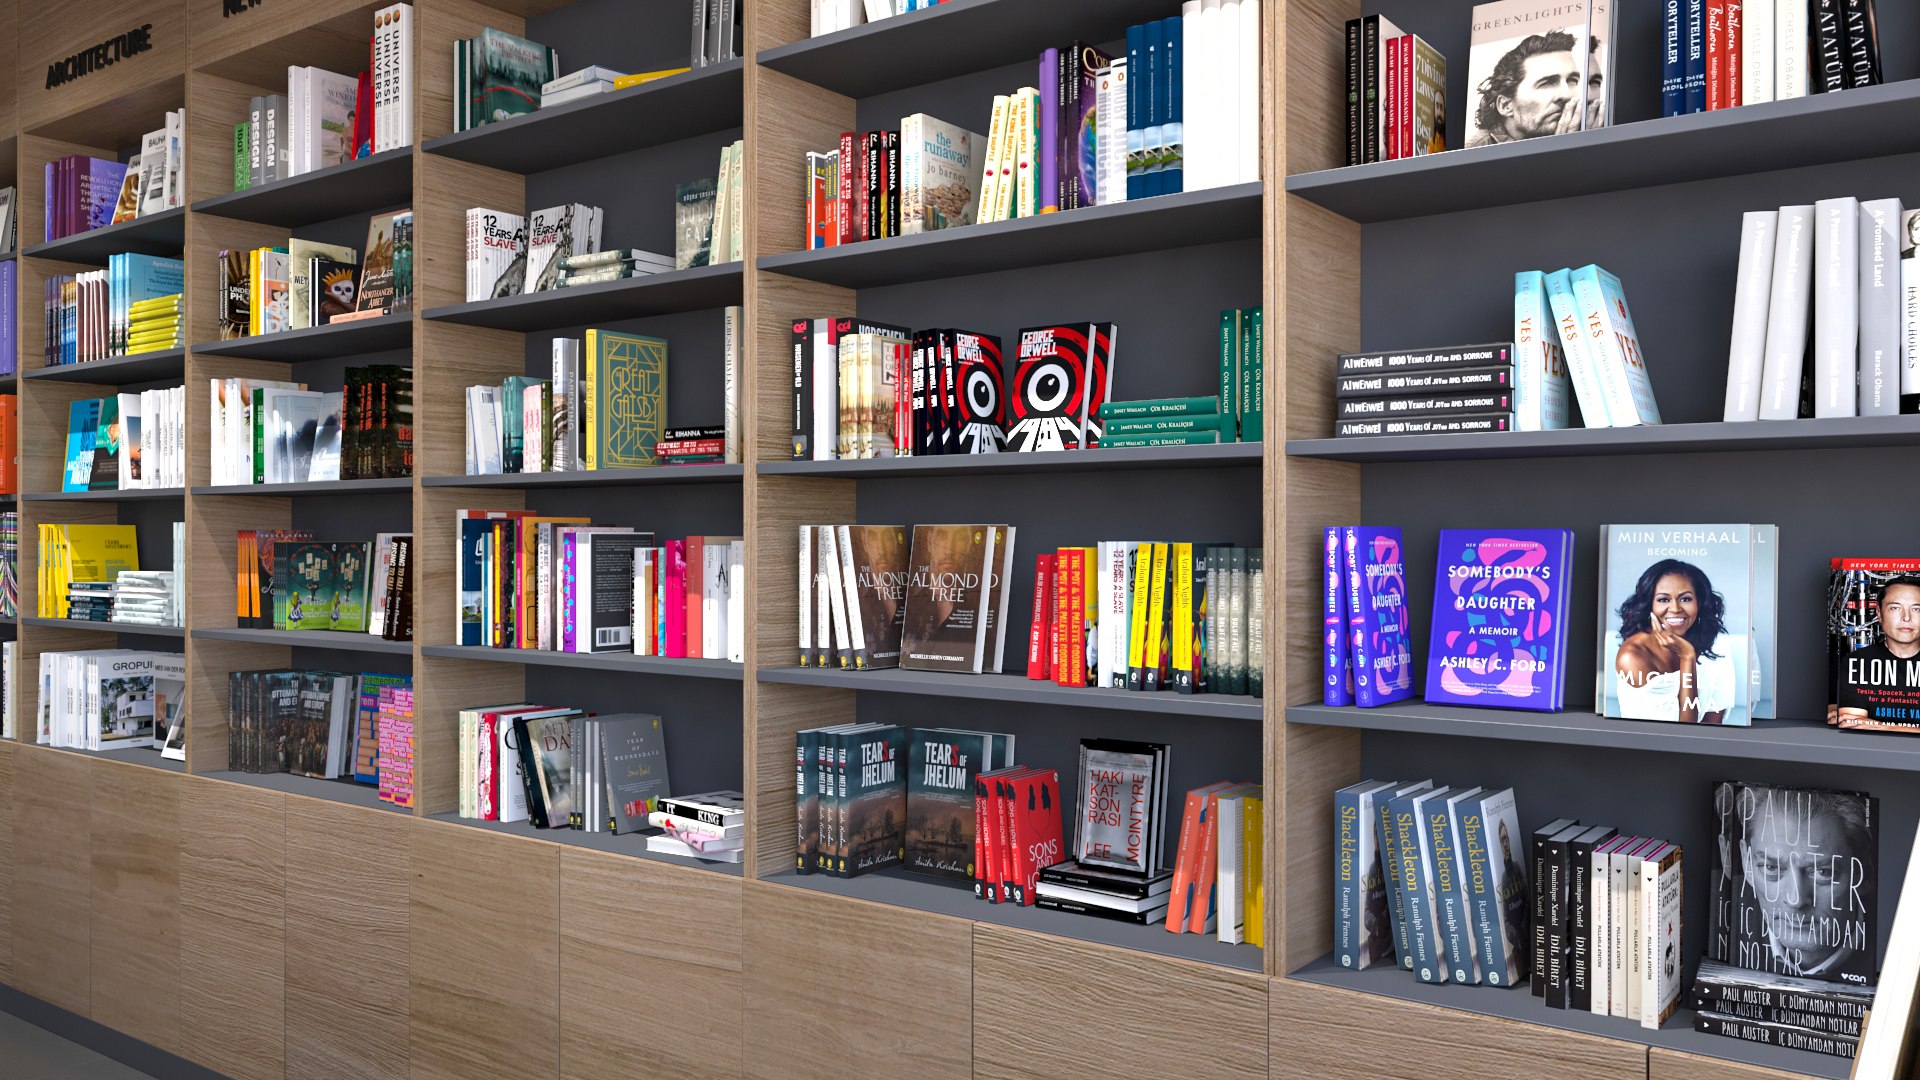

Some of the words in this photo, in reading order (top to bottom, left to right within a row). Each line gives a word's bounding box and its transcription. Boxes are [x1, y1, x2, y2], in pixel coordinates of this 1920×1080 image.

[1473, 3, 1582, 32] GREENLIGHTS
[1709, 4, 1723, 53] Beethoven
[1668, 0, 1678, 64] ORYTELLER
[46, 24, 152, 89] ARCHITECTURE
[1417, 77, 1434, 101] Laws
[267, 109, 275, 167] DESIGN
[1417, 117, 1431, 138] Best
[252, 110, 260, 168] DESIGN
[936, 133, 951, 148] the
[925, 141, 968, 166] runaway
[928, 162, 936, 174] jo
[939, 166, 967, 185] barney
[700, 190, 717, 198] ERSANL
[484, 215, 496, 227] 12
[534, 215, 544, 227] 12
[681, 204, 712, 224] BULU
[484, 226, 512, 240] YEARS
[513, 228, 523, 242] A
[533, 225, 555, 237] YEARS
[555, 218, 563, 232] A
[686, 226, 709, 243] FAL
[484, 237, 516, 250] SLAVE
[532, 234, 557, 246] SLAVE
[1874, 219, 1885, 262] Promised
[1874, 264, 1884, 287] Land
[360, 287, 394, 301] NORTHANGER
[368, 297, 383, 308] ABBEY
[1909, 286, 1917, 317] HARD
[1521, 318, 1531, 342] YES
[1562, 314, 1578, 341] YES
[1588, 311, 1603, 338] YES
[957, 334, 979, 349] GEORGE
[1022, 330, 1054, 344] GEORGE
[1909, 319, 1917, 369] CHOICES
[957, 347, 984, 363] ORWELL
[1020, 342, 1057, 357] ORWELL
[1389, 356, 1406, 365] 1000
[1407, 354, 1424, 364] YEARS
[1463, 352, 1492, 360] SORROWS
[1874, 350, 1882, 376] Barack
[612, 366, 659, 393] GREAT
[611, 393, 659, 420] GATSBY
[675, 430, 701, 438] RIHANNA
[1618, 532, 1655, 544] MIJN
[1661, 531, 1740, 544] VERHAAL
[390, 542, 398, 567] RISING
[399, 542, 407, 567] RISING
[1059, 555, 1067, 569] THE
[1647, 548, 1708, 556] BECOMING
[858, 571, 908, 588] ALMOND
[910, 573, 978, 589] ALMOND
[1059, 571, 1067, 585] POT
[1139, 558, 1147, 582] Arabian
[1156, 558, 1164, 582] Arabian
[1366, 563, 1403, 577] SOMEBODY'S
[1448, 565, 1550, 578] SOMEBODY'S
[874, 586, 903, 600] TREE
[930, 587, 964, 602] TREE
[1137, 586, 1145, 607] Nights
[1154, 585, 1162, 607] Nights
[1372, 595, 1401, 609] DAUGHTER
[1456, 596, 1535, 611] DAUGHTER
[1059, 612, 1067, 643] PALETTE
[1479, 627, 1518, 636] MEMOIR
[1059, 644, 1067, 683] COOKBOOK
[1440, 656, 1488, 670] ASHLEY
[1494, 659, 1506, 671] C.
[1510, 659, 1546, 672] FORD
[1848, 658, 1897, 686] ELON
[1856, 688, 1876, 696] Tesla,
[1876, 707, 1906, 718] ASHLEE
[614, 751, 659, 761] WEDNESDAYS
[861, 740, 888, 765] TEARS
[889, 747, 895, 760] OF
[924, 741, 959, 767] TEARS
[959, 755, 968, 767] OF
[861, 760, 895, 788] JHELUM
[923, 766, 967, 790] JHELUM
[1091, 770, 1124, 784] HAKİ
[1090, 783, 1119, 797] KAT-
[666, 803, 676, 815] IT
[698, 810, 720, 825] KING
[1089, 797, 1120, 812] SON
[1088, 810, 1120, 827] RASI
[1127, 773, 1145, 862] MCINTYRE
[1737, 787, 1819, 848] PAUL
[1029, 839, 1057, 862] SONS
[1086, 842, 1111, 858] LEE
[1341, 806, 1356, 881] Shackleton
[1430, 814, 1451, 892] Shackleton
[858, 856, 874, 870] Anita
[875, 850, 898, 864] Krishnan
[915, 856, 934, 868] Anita
[936, 862, 965, 873] Krishnan
[1396, 814, 1418, 892] Shackleton
[1411, 897, 1423, 930] Ranulph
[1417, 932, 1426, 962] Fiennes
[1550, 865, 1558, 901] Dominique
[1741, 846, 1866, 913] AUSTER
[1343, 887, 1351, 919] Ranulph
[1343, 920, 1351, 948] Fiennes
[1741, 902, 1754, 939] İÇ
[1762, 908, 1866, 951] DÜNYAMDAN
[1551, 934, 1560, 956] İDİL
[1740, 940, 1803, 977] NOTLAR
[1551, 957, 1560, 988] BİRET
[1723, 987, 1741, 1000] PAUL
[1743, 989, 1771, 1005] AUSTER
[1790, 994, 1835, 1013] DÜNYAMDAN
